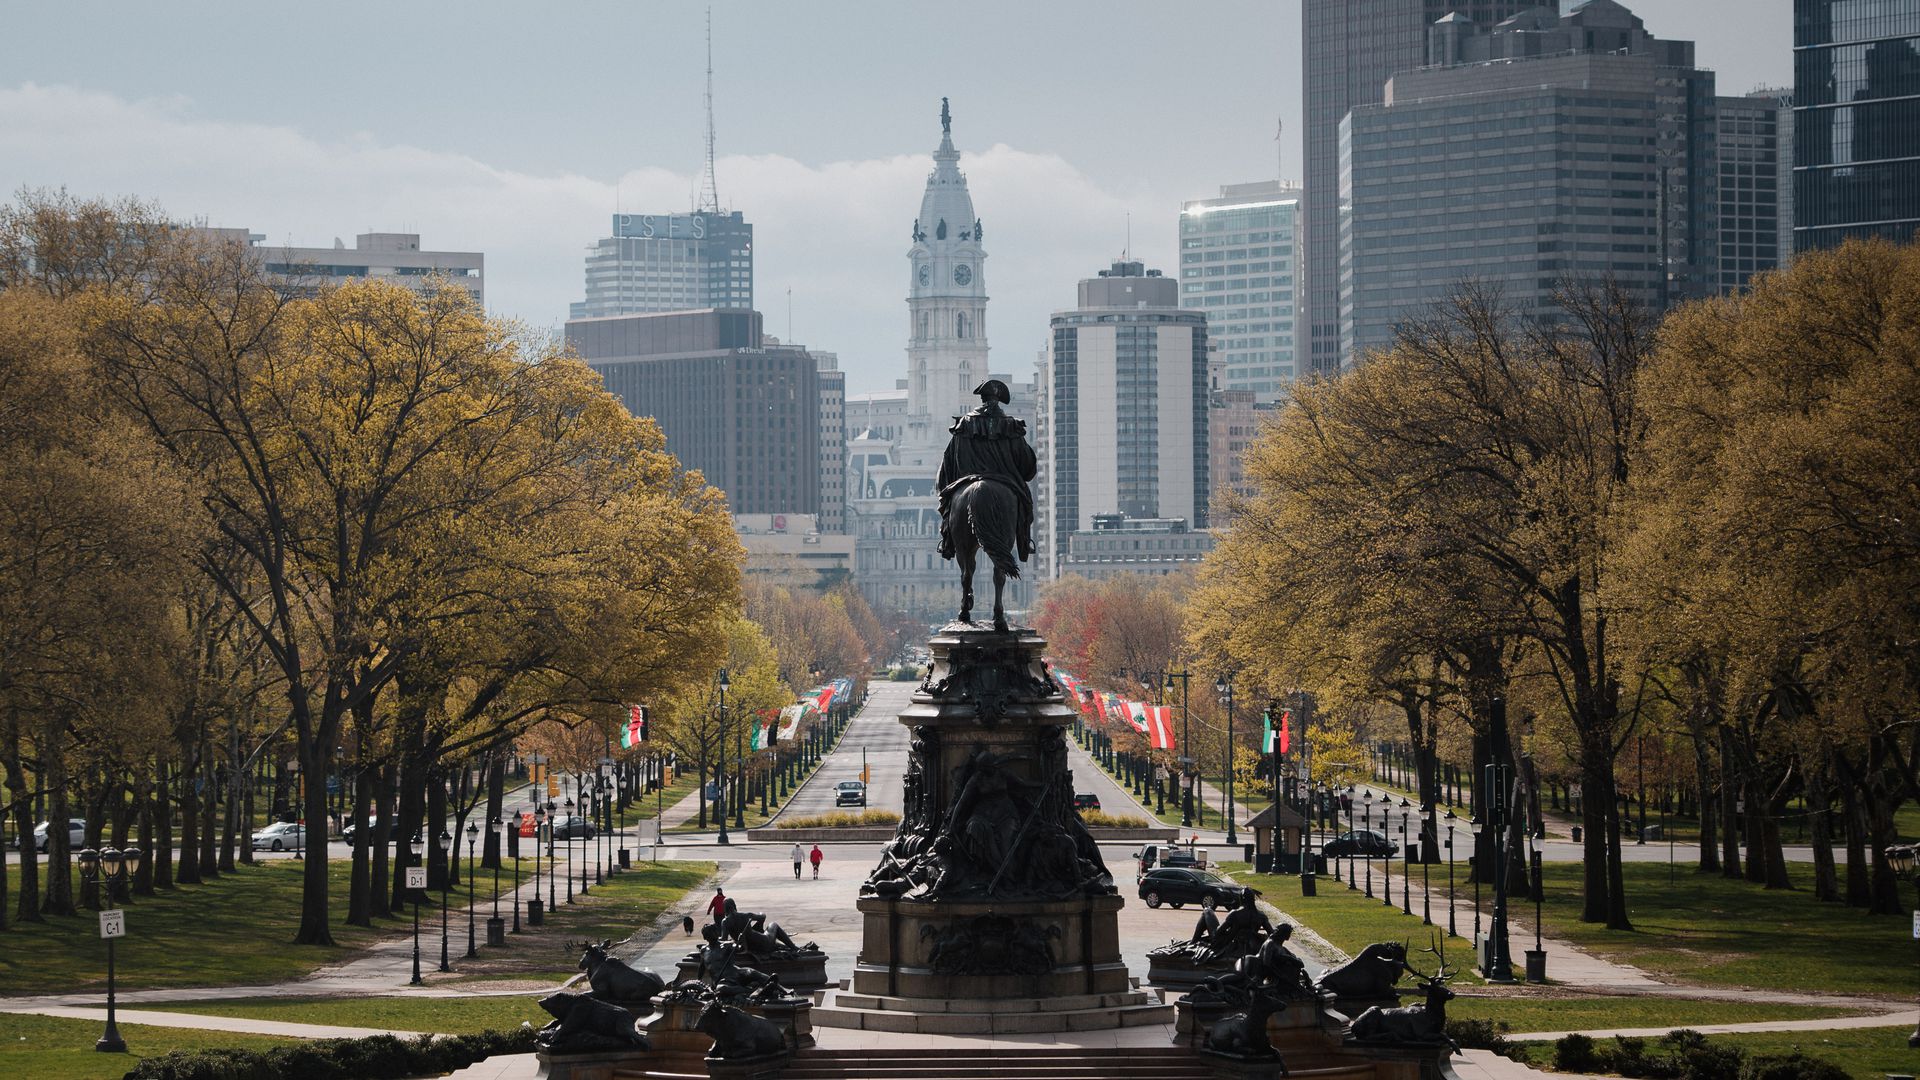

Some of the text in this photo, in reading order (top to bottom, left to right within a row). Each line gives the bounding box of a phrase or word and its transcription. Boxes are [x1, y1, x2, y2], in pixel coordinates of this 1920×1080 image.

[619, 214, 705, 239] PSFS
[410, 876, 423, 886] D-1
[106, 921, 120, 935] C-1
